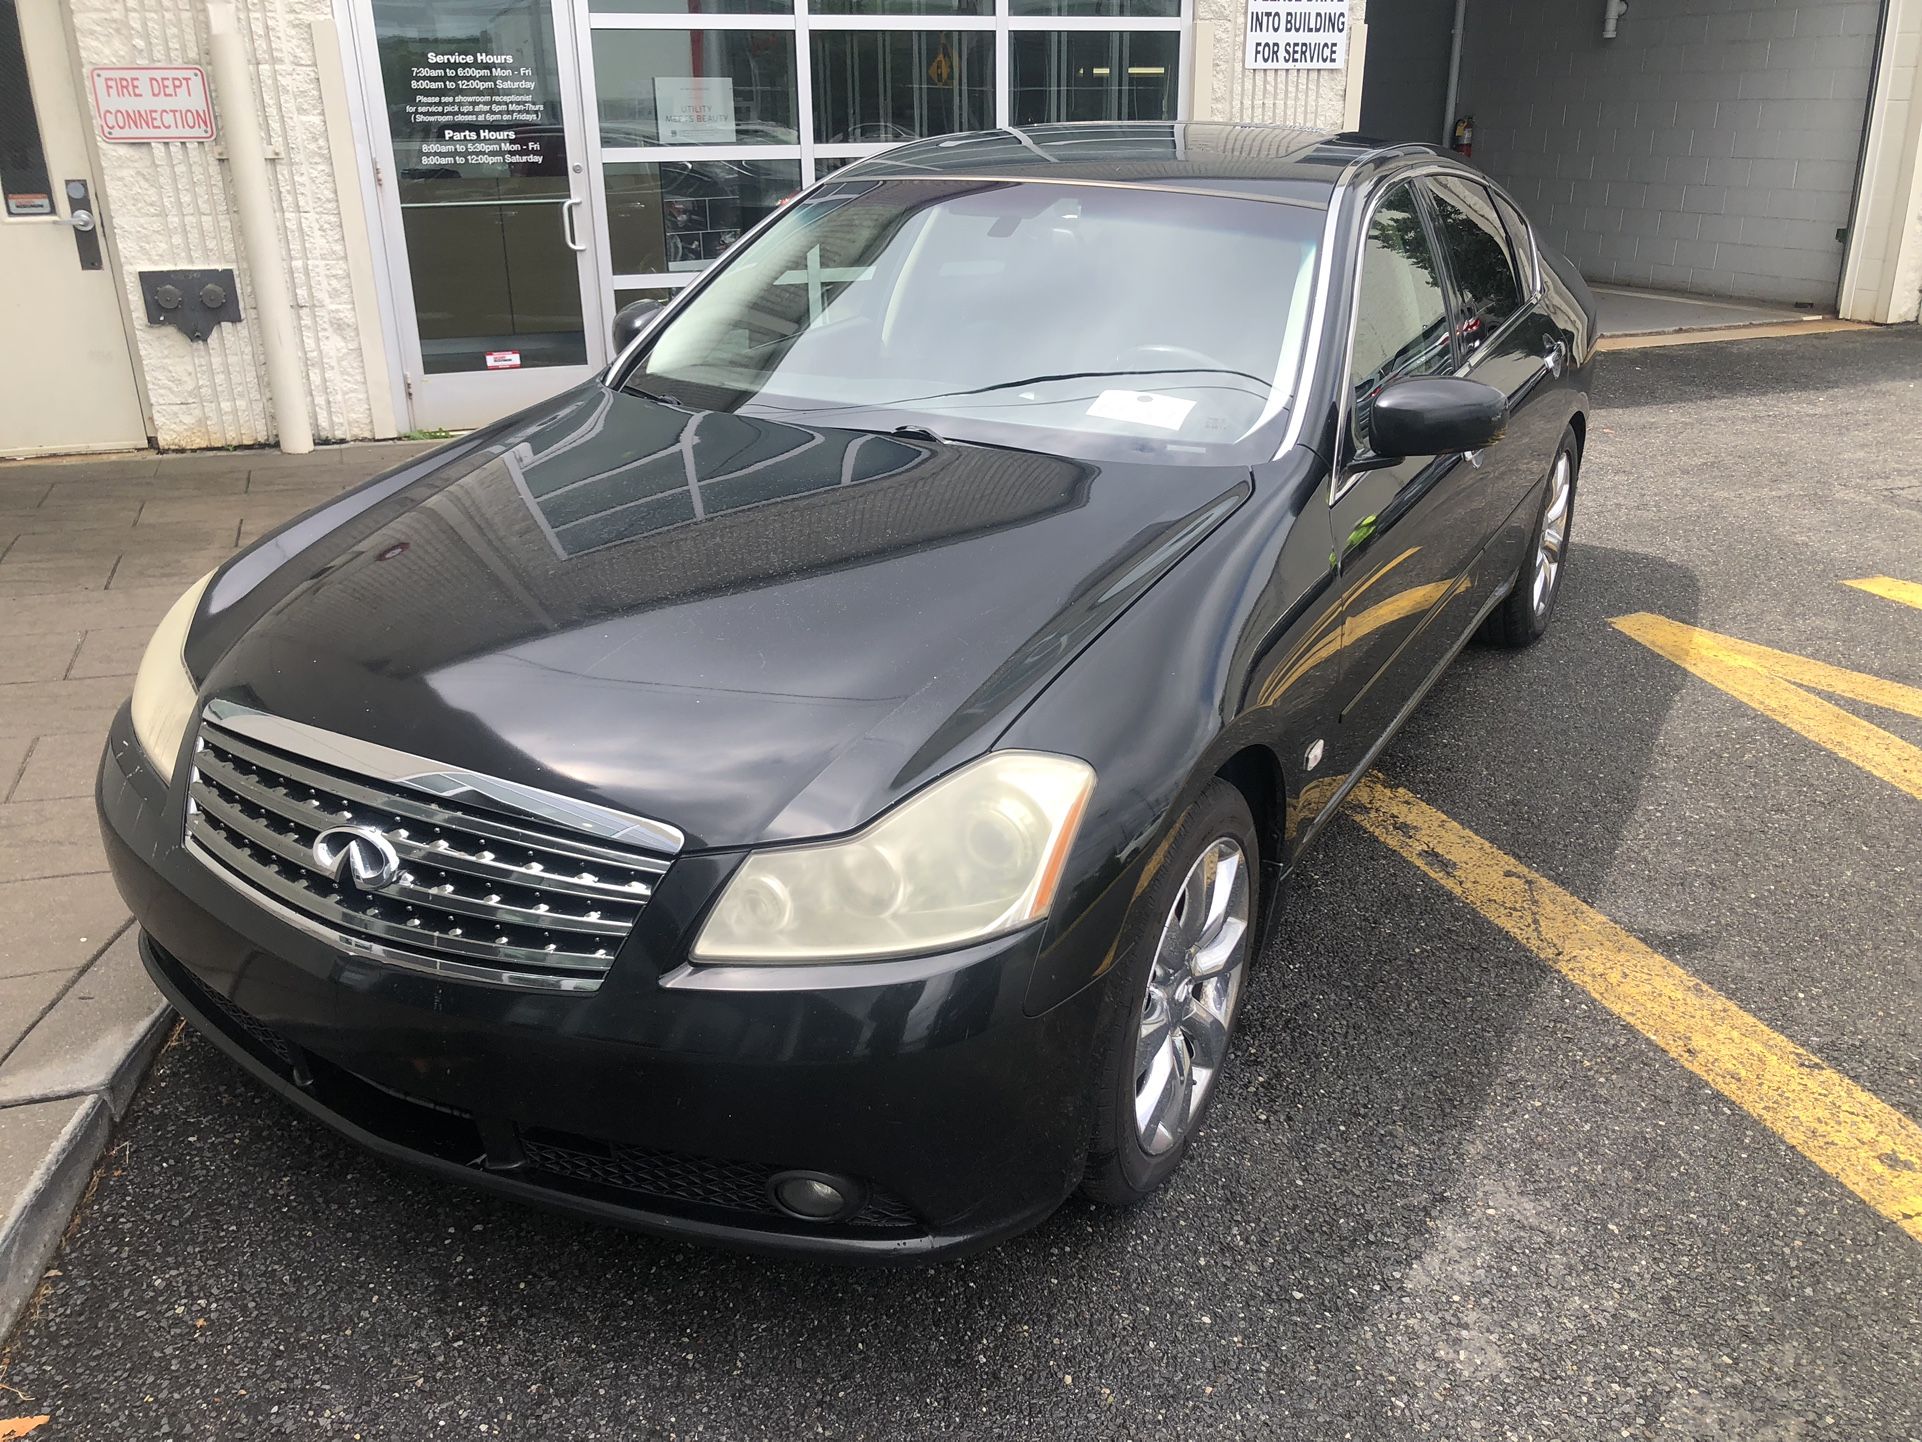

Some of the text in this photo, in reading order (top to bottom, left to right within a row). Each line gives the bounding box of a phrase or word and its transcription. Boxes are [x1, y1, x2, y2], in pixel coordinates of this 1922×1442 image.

[1250, 11, 1346, 33] INTO BUILDING
[427, 52, 514, 63] Service Hours
[1254, 42, 1338, 63] FOR SERVICE
[411, 67, 445, 77] 7:30am
[446, 68, 456, 77] to
[457, 67, 491, 79] 6:00pm
[491, 67, 513, 77] Mon
[520, 67, 532, 76] Fri
[104, 77, 192, 98] FIRE DEPT
[411, 79, 536, 90] 8:00am to 12:00pm Saturday
[416, 95, 440, 103] Please
[492, 94, 532, 103] receptionist
[405, 103, 544, 114] for service pick ups after 6pm Mon-Thurs
[103, 109, 209, 130] CONNECTION
[415, 114, 454, 122] Showroom
[454, 113, 477, 121] closes
[477, 113, 485, 121] at
[485, 113, 502, 122] 6pm
[512, 112, 537, 122] Fridays
[444, 129, 516, 140] Parts Hours
[421, 143, 455, 152] 8:00am
[456, 144, 466, 152] to
[467, 143, 500, 153] 5:30pm
[501, 142, 521, 151] Mon
[528, 142, 540, 151] Fri
[421, 154, 544, 165] 8:00am to 12:00pm Saturday
